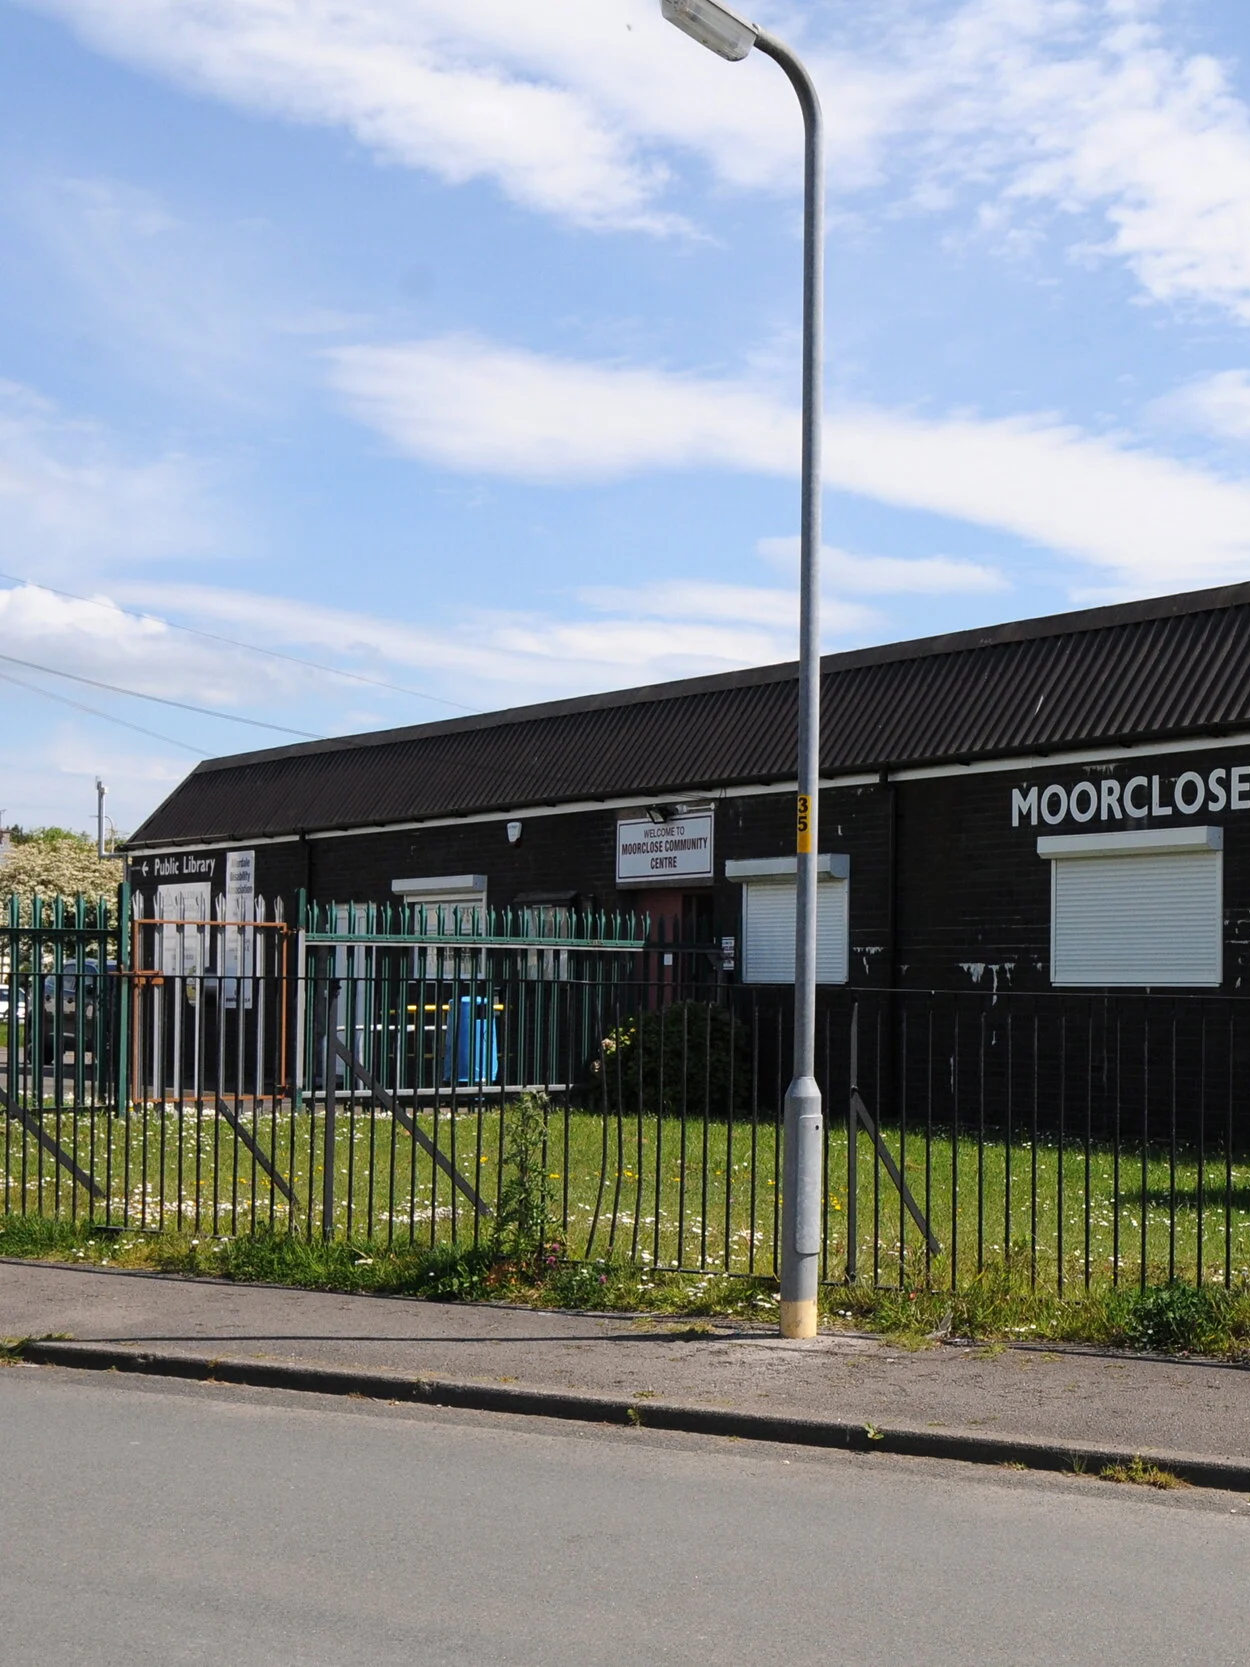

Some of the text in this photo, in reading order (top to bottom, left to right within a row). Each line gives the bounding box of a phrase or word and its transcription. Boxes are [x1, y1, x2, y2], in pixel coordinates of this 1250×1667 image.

[643, 826, 685, 839] WELCOME TO
[621, 837, 708, 856] MOORCLOSE COMMUNITY
[154, 856, 216, 877] Public Library
[650, 856, 678, 870] CENTRE
